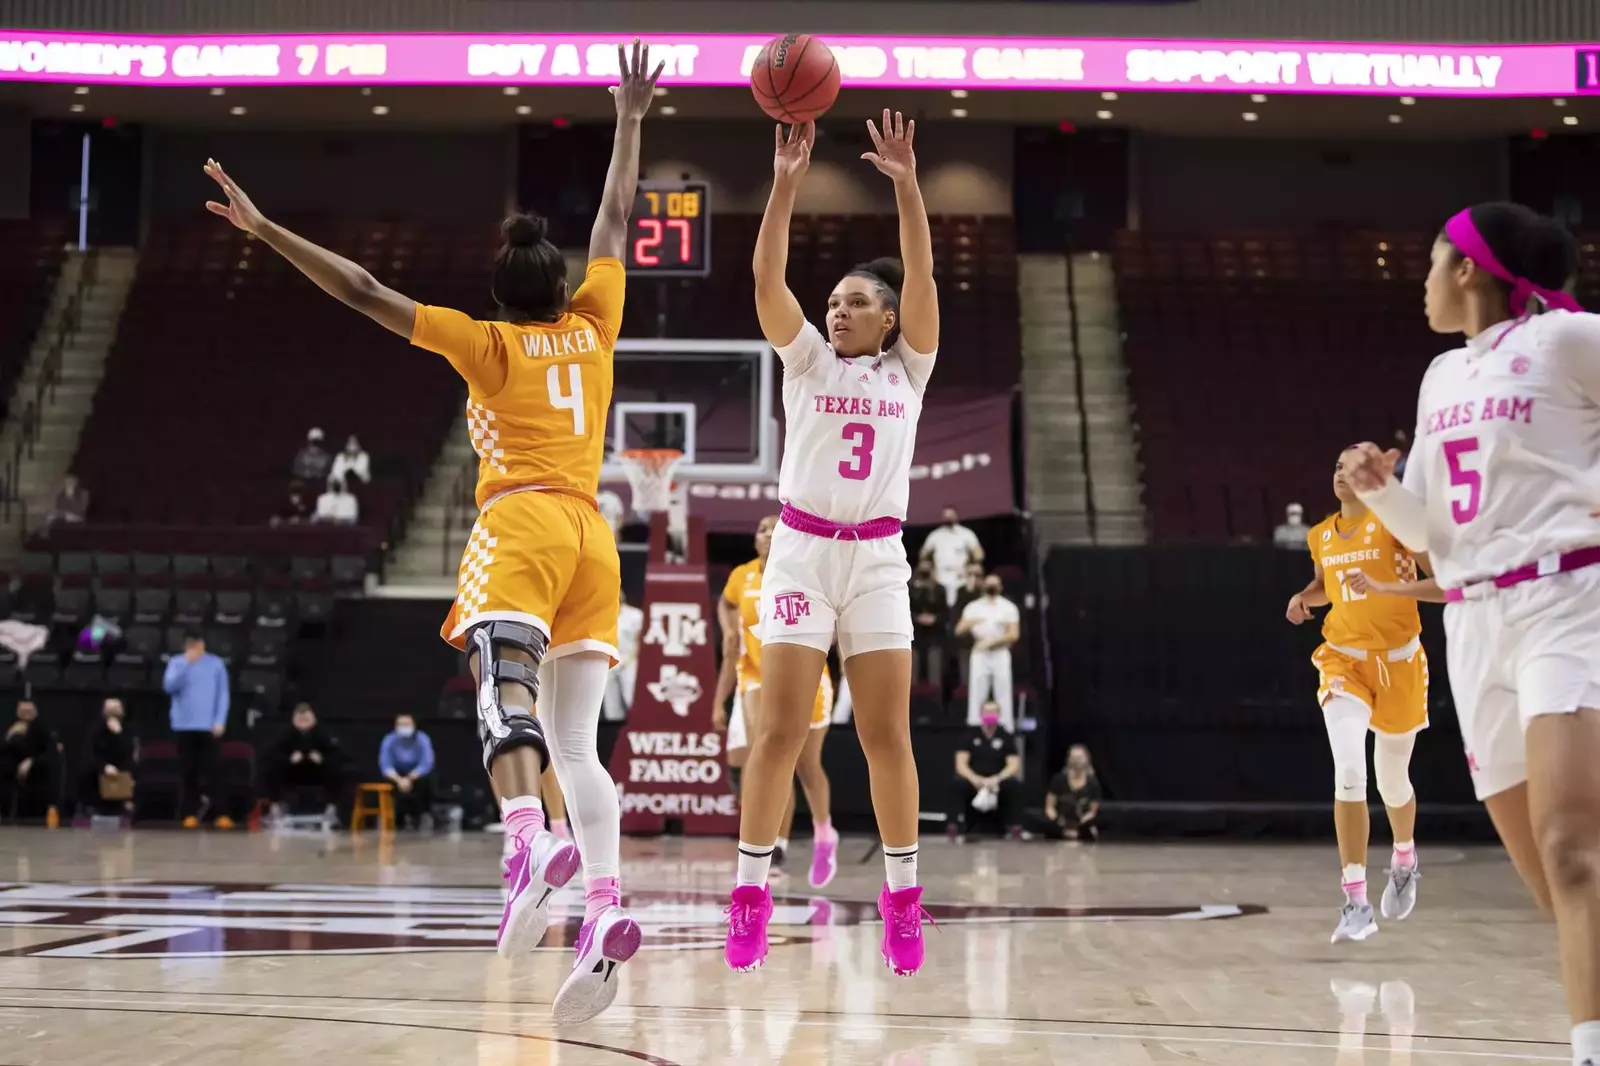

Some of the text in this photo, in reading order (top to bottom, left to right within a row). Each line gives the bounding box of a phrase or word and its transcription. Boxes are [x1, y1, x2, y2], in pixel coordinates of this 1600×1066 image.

[172, 44, 280, 77] GAME
[296, 44, 319, 76] 7
[325, 44, 387, 76] PM
[467, 43, 547, 76] BUY
[551, 43, 581, 76] A
[892, 46, 966, 79] THE
[972, 47, 1084, 80] GAME
[1125, 49, 1502, 87] SUPPORT VIRTUALLY
[634, 218, 690, 265] 27
[522, 328, 596, 357] WALKER
[546, 363, 585, 436] 4
[814, 395, 905, 419] TEXAS A&M
[1425, 401, 1476, 436] EXAS
[838, 422, 875, 481] 3
[1443, 437, 1481, 525] 5
[628, 731, 721, 756] WELLS
[629, 759, 721, 784] FARGO
[617, 789, 738, 816] PPORTUNE
